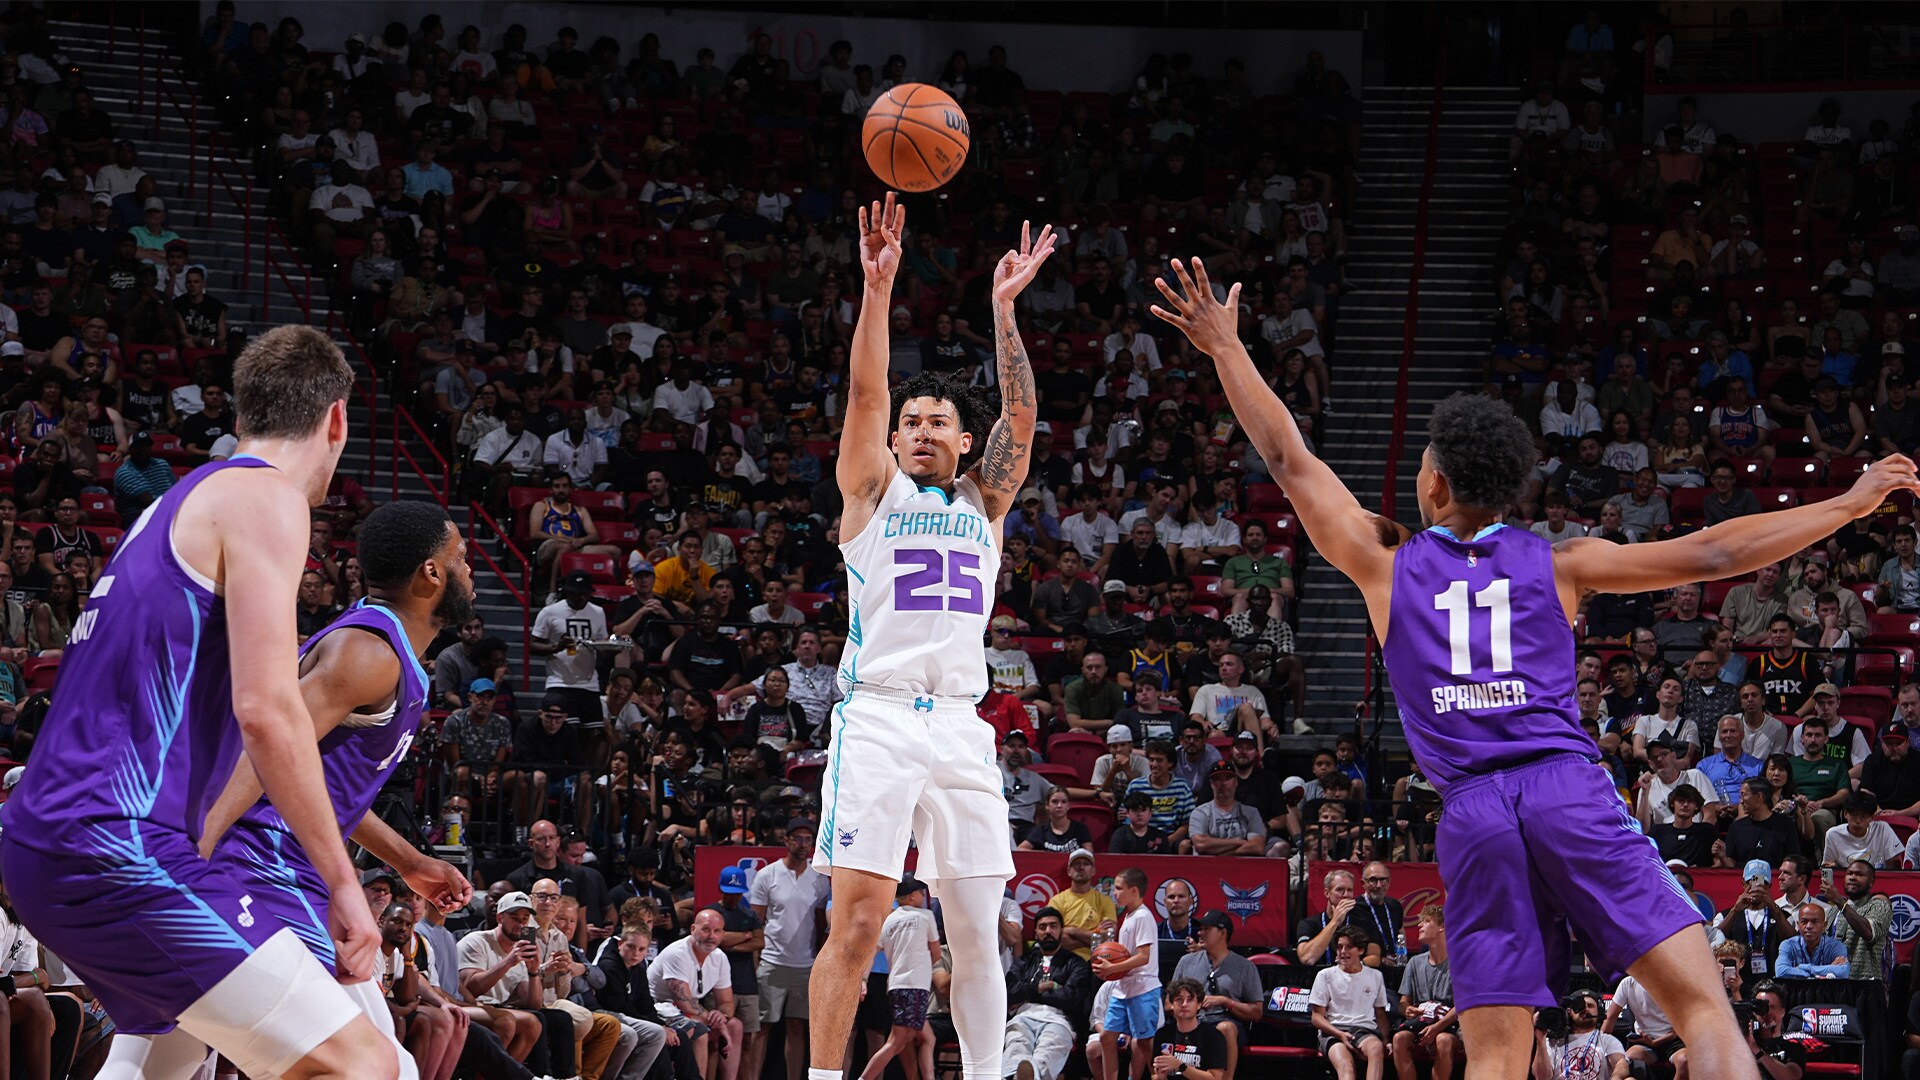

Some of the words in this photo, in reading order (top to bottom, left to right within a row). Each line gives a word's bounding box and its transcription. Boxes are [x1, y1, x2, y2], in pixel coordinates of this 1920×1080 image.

[998, 423, 1011, 448] ME?
[991, 444, 1004, 466] NOT
[985, 461, 998, 488] WHY
[894, 548, 984, 615] 25
[1434, 578, 1513, 675] 11
[1431, 680, 1527, 714] SPRINGER
[1763, 679, 1802, 695] PHX
[1227, 901, 1260, 911] HORNETS
[1287, 993, 1311, 1003] SUMME
[1818, 1014, 1848, 1025] SUMMER
[1818, 1024, 1845, 1035] LEAGUE
